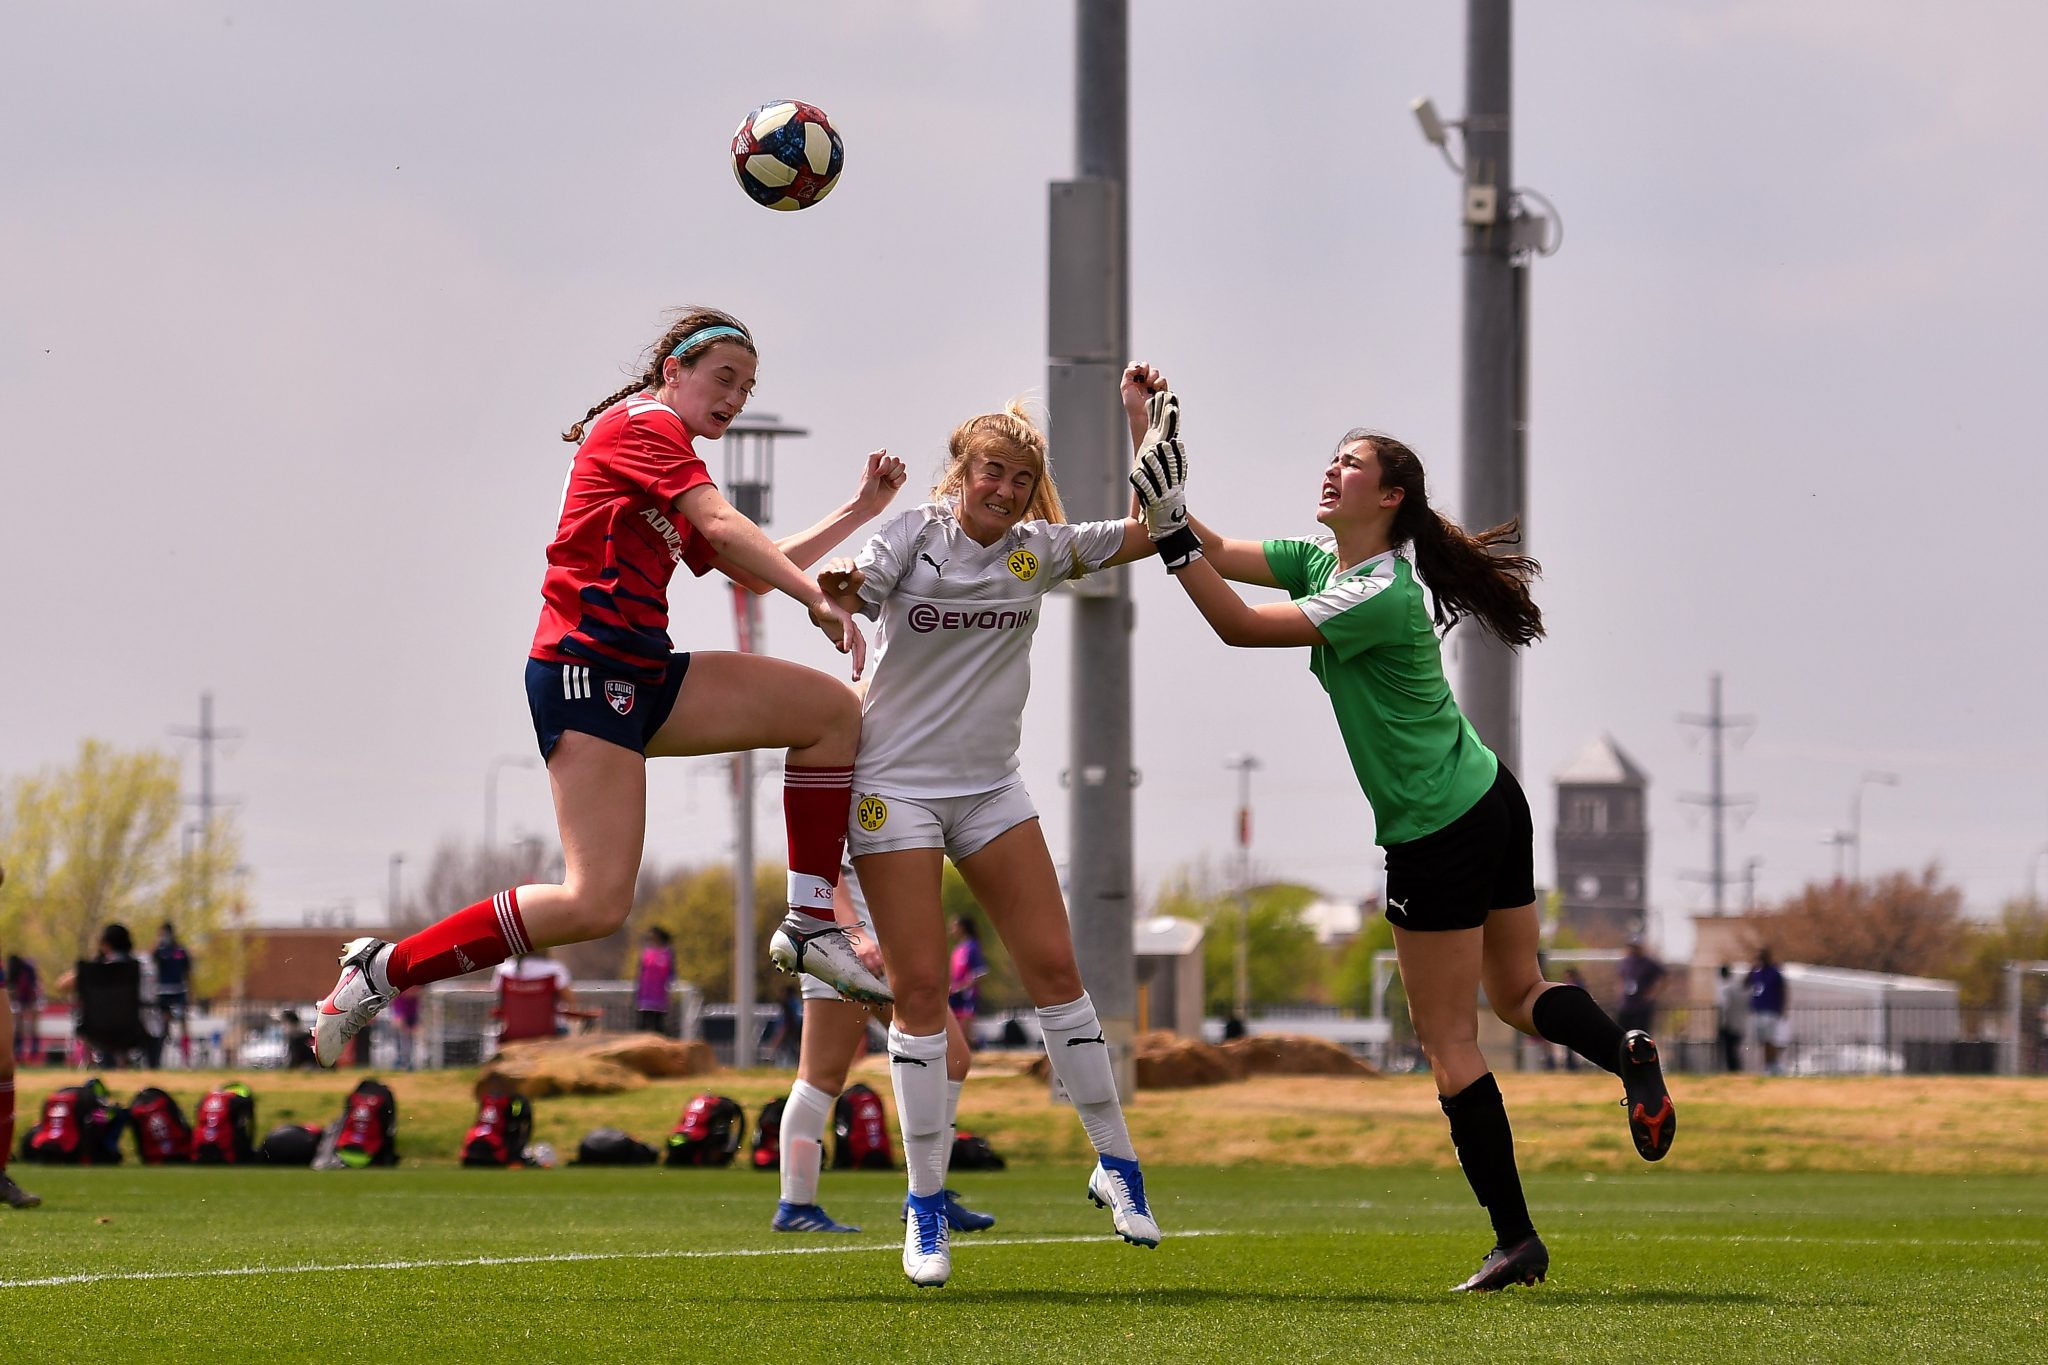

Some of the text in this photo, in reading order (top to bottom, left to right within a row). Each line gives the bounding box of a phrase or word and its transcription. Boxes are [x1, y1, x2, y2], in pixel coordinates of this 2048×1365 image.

[1011, 553, 1036, 573] BVB
[942, 609, 1033, 630] EVONIK
[607, 682, 632, 695] FC DALLAS
[860, 800, 884, 822] BVB
